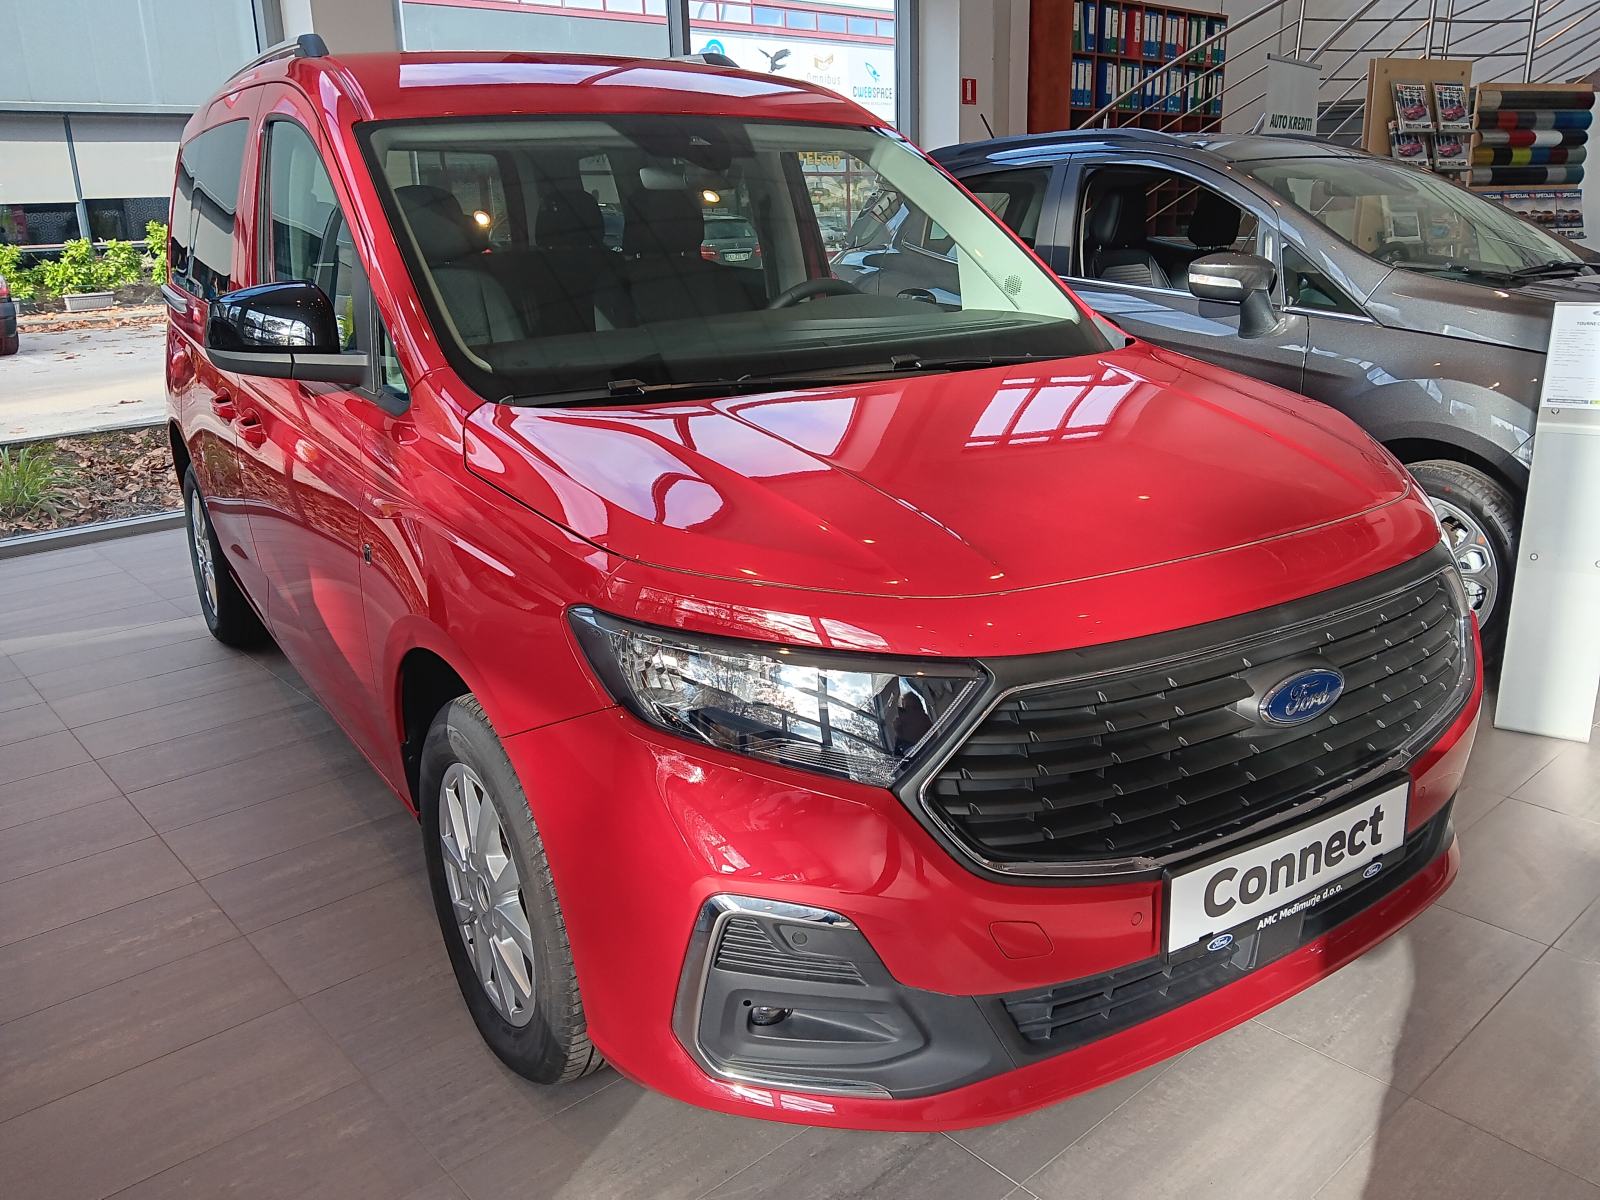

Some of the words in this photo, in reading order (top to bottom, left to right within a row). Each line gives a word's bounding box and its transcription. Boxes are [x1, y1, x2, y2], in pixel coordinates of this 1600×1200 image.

[1270, 113, 1288, 129] AUTO
[1288, 115, 1313, 131] KREDITI
[1286, 680, 1330, 716] Ford
[1203, 804, 1385, 919] Connect
[1257, 912, 1278, 931] AMC
[1322, 884, 1343, 899] d.o.o.
